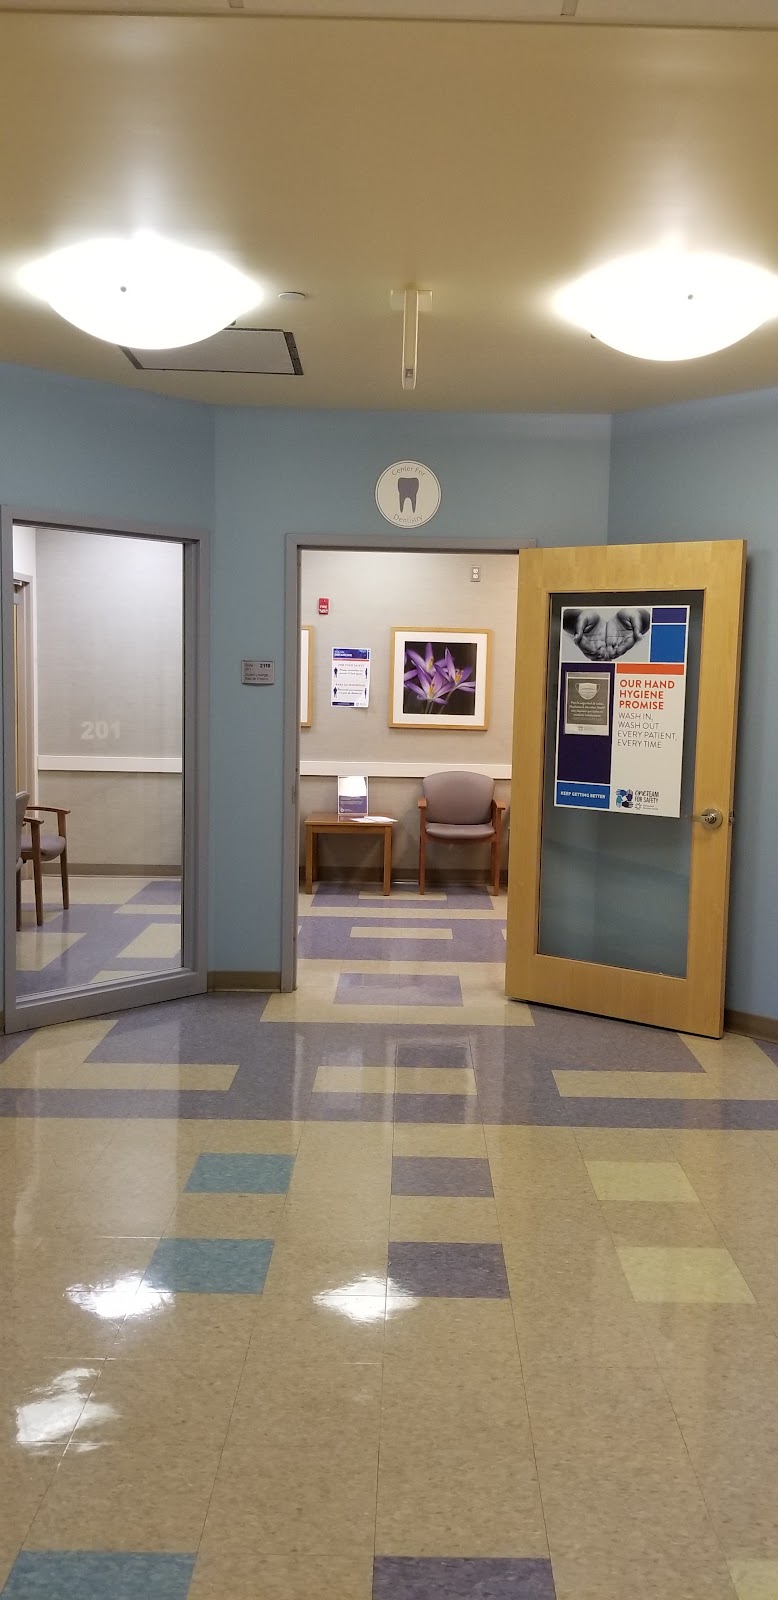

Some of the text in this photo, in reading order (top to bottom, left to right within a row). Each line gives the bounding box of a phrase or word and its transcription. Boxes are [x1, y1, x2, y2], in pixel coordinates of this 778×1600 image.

[391, 466, 426, 477] Center For
[393, 513, 423, 524] Dentistry
[620, 679, 675, 689] OUR HAND
[619, 689, 664, 699] HYGIENE
[619, 700, 664, 710] PROMISE
[618, 712, 653, 721] WASH IN,
[80, 720, 121, 740] 201
[618, 721, 640, 729] WASH
[617, 730, 677, 741] EVERY PATIENT,
[617, 739, 662, 748] EVERY TIME
[643, 796, 659, 804] SAFETY
